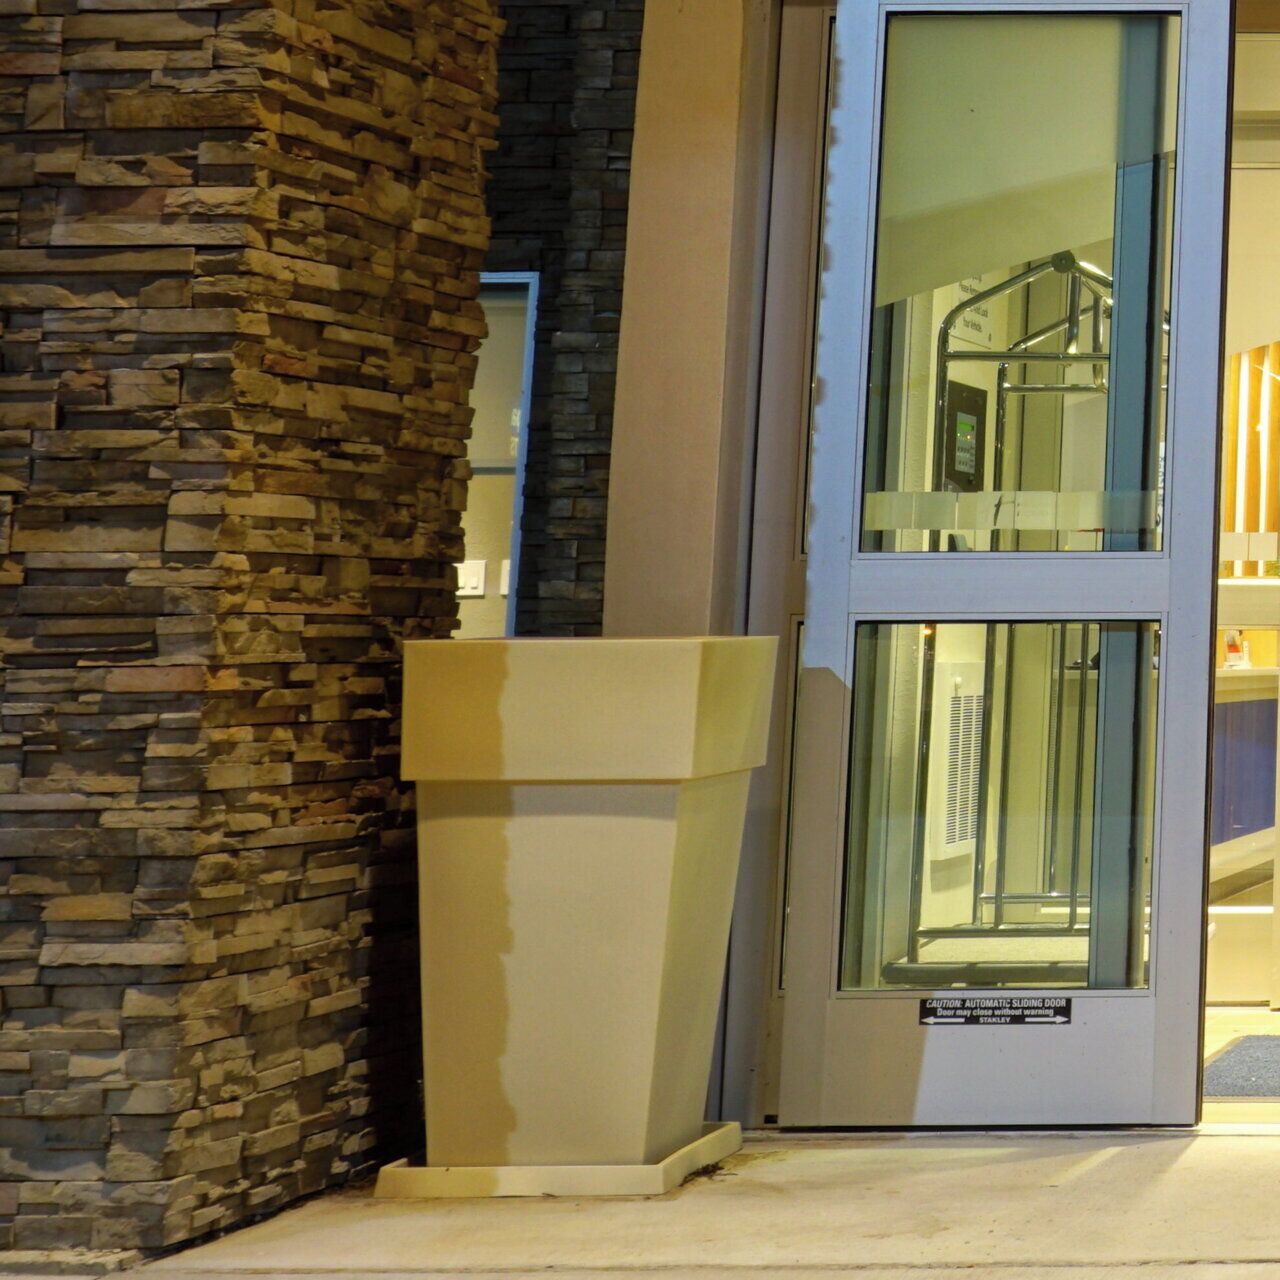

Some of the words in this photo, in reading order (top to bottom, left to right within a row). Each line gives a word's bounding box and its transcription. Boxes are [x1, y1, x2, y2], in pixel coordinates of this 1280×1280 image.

[926, 1000, 963, 1008] CAUTION:
[965, 999, 1011, 1008] AUTOMATIC
[1012, 999, 1043, 1007] SLIDING
[1045, 999, 1066, 1007] DOOR
[937, 1008, 954, 1016] Door
[973, 1008, 993, 1016] close
[994, 1008, 1022, 1016] without
[1024, 1009, 1054, 1017] warning
